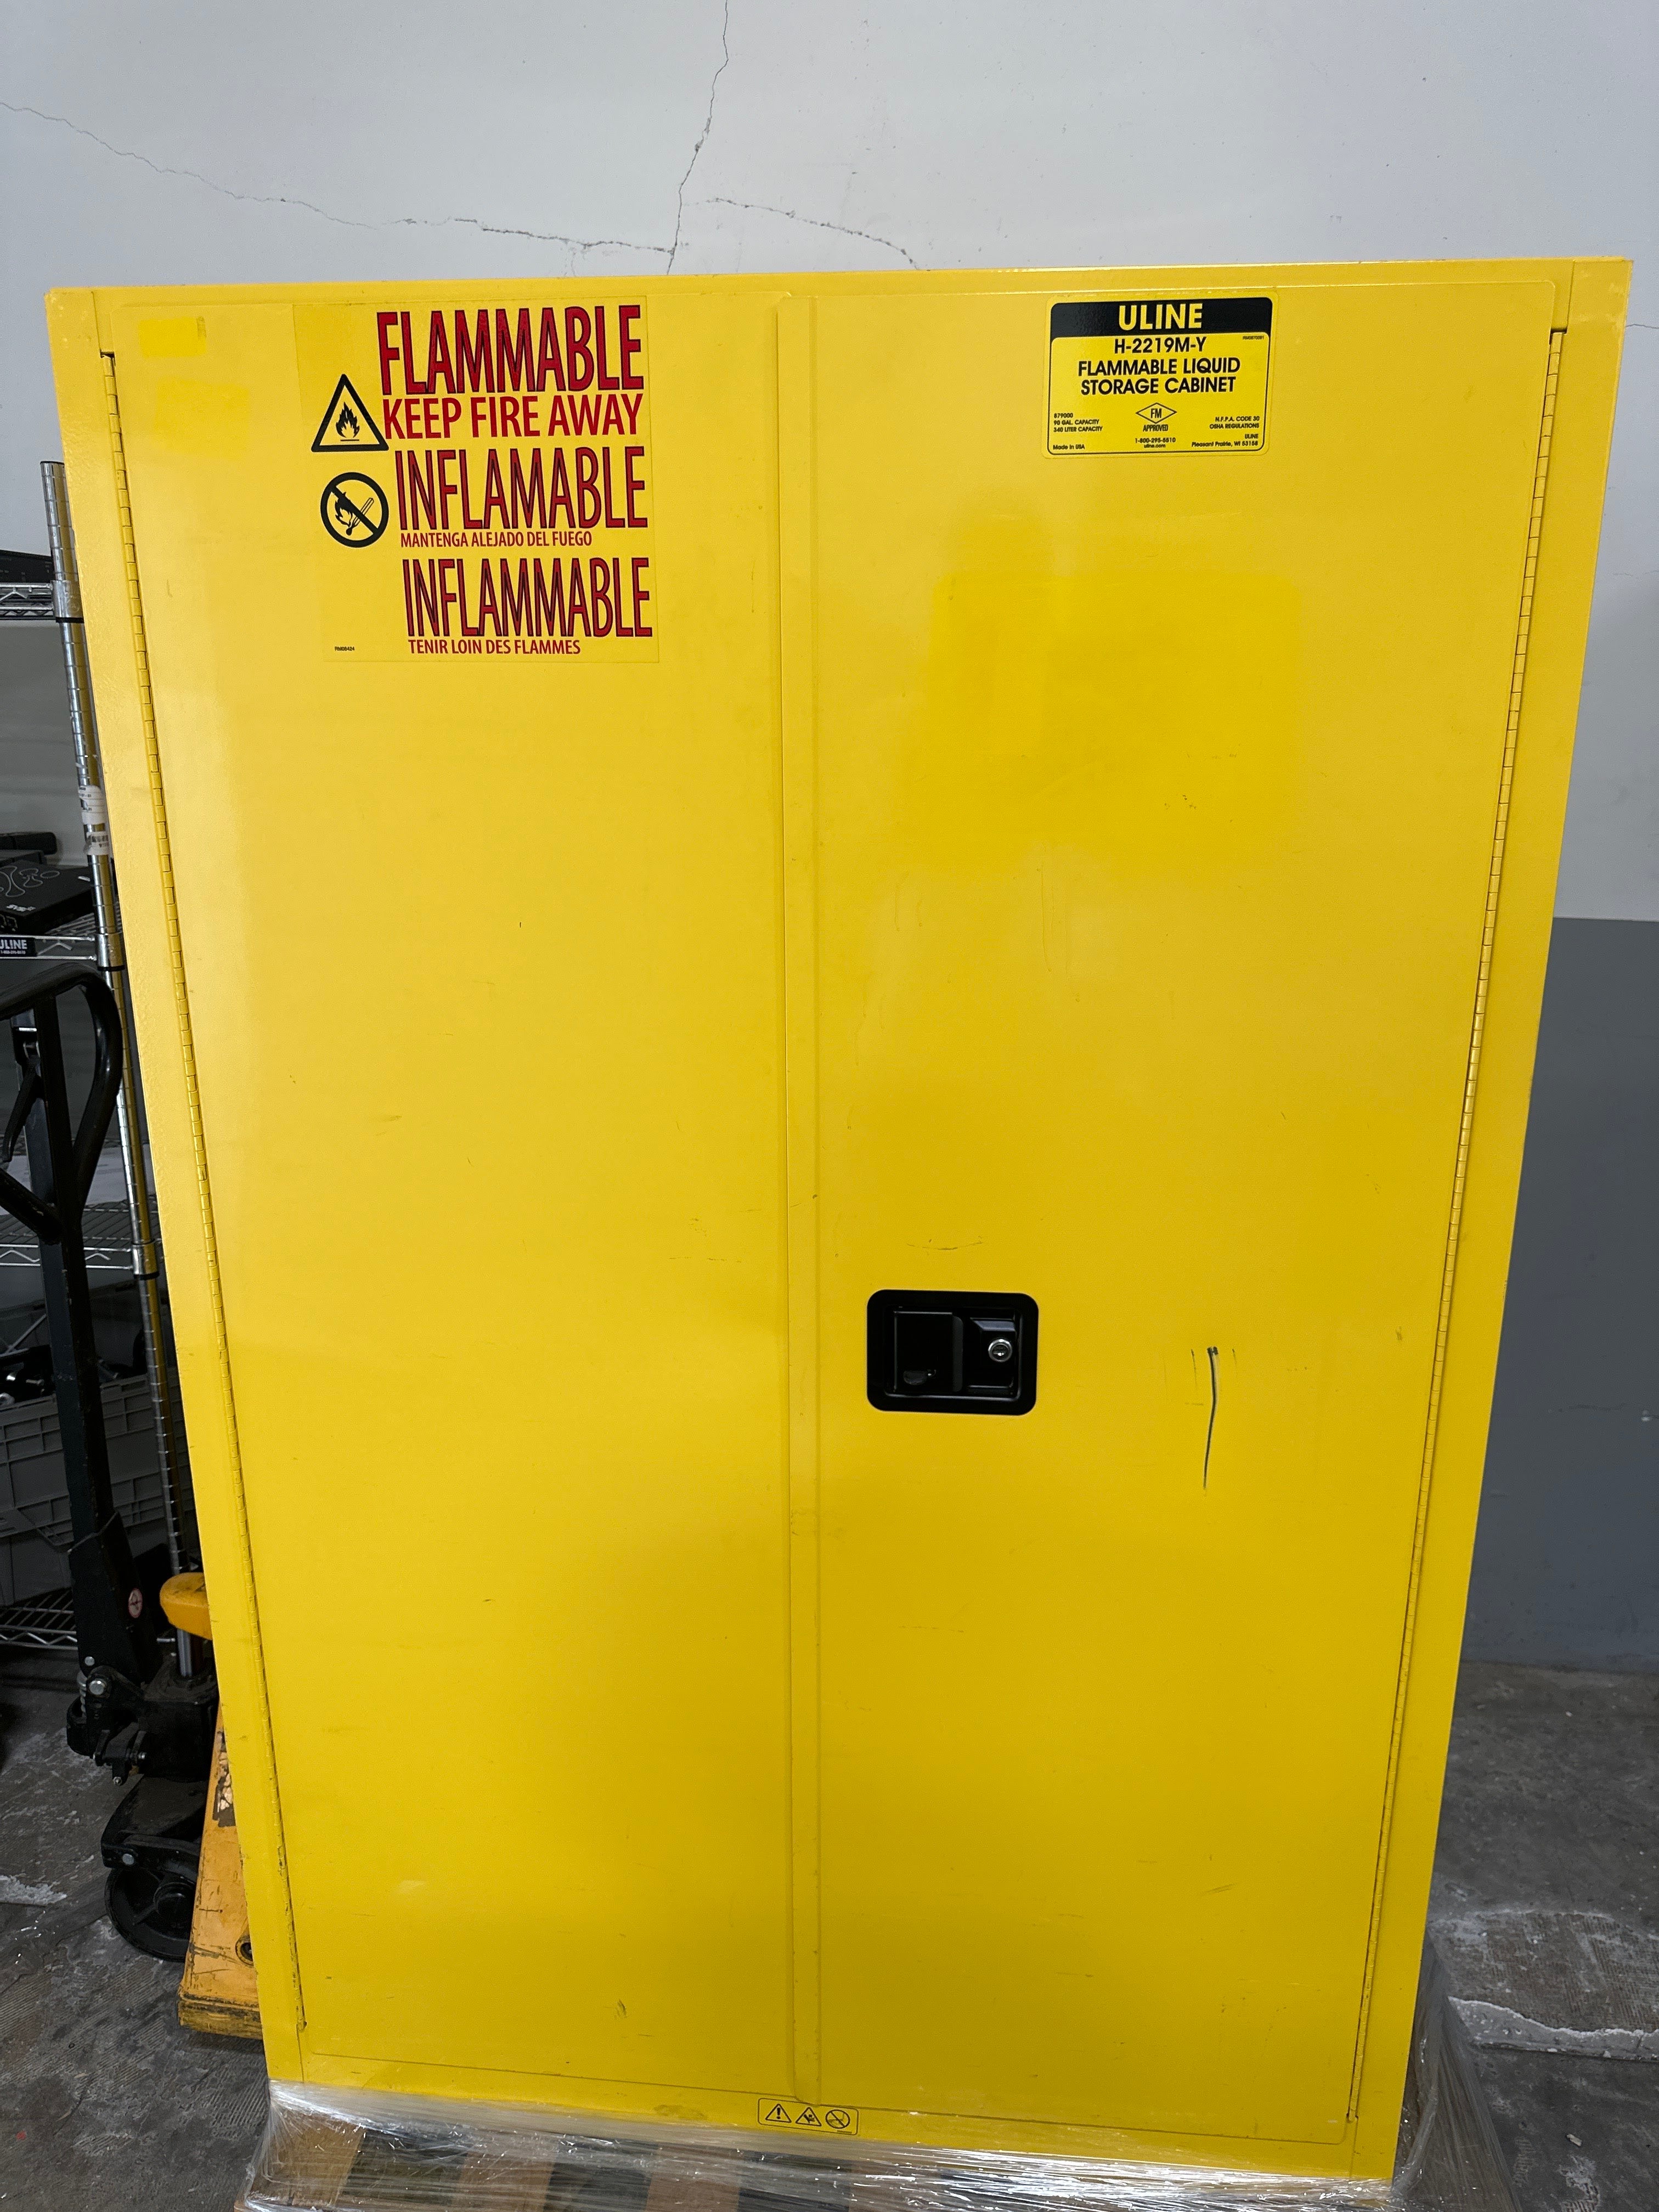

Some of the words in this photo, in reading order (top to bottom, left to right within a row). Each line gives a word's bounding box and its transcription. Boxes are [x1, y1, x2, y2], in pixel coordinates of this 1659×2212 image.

[1118, 303, 1203, 331] ULINE
[376, 305, 644, 396] FLAMMABLE
[1114, 337, 1206, 354] H-2219M-Y
[1078, 359, 1177, 376] FLAMMABLE
[1183, 357, 1240, 374] LIQUID
[1081, 379, 1159, 395] STORAGE
[1165, 376, 1235, 393] CABINET
[382, 398, 462, 439] KEEP
[471, 396, 540, 438] FIRE
[548, 393, 643, 436] AWAY
[1151, 408, 1162, 418] FM
[395, 446, 648, 530] INFLAMABLE
[401, 533, 469, 548] MANTENGA
[471, 532, 524, 547] ALEJADO
[527, 532, 549, 546] DEL
[552, 531, 591, 546] FUEGO
[403, 557, 652, 637] INFLAMMABLE
[409, 640, 449, 655] TENIR
[452, 640, 483, 654] LOIN
[487, 640, 511, 654] DES
[514, 640, 580, 654] FLAMMES
